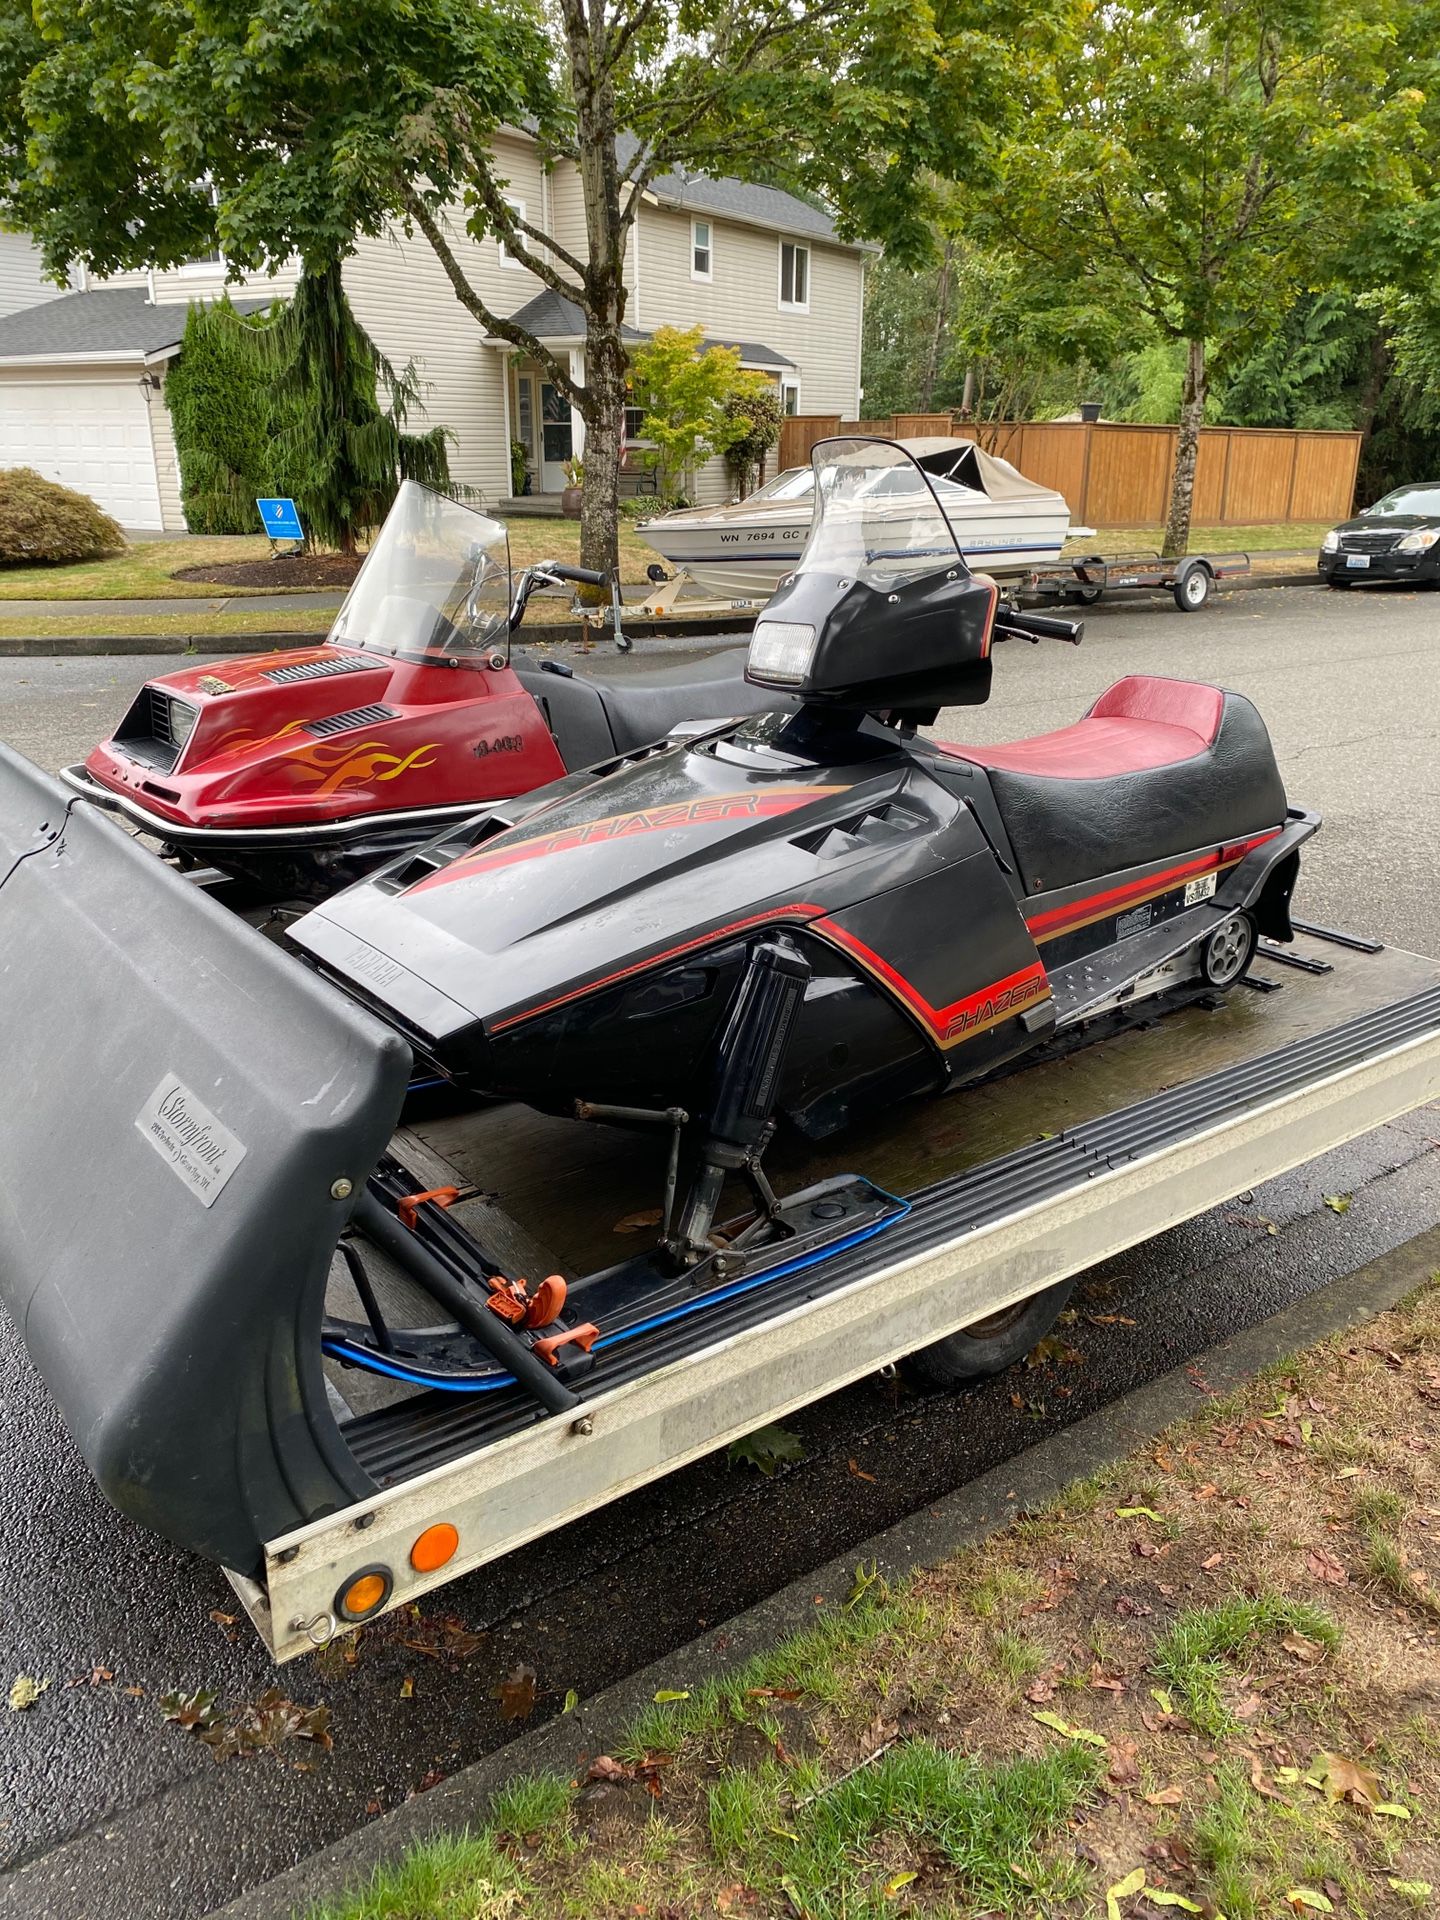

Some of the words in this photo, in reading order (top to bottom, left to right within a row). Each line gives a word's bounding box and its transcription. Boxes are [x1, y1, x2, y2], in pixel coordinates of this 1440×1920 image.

[720, 534, 739, 542] WN
[746, 532, 775, 541] 7694
[782, 530, 799, 539] GC
[969, 537, 1023, 547] BAYLINER
[547, 794, 760, 852] PHAZER
[344, 944, 405, 988] YAMAHA
[946, 975, 1041, 1040] PHAZER
[159, 1090, 228, 1167] Stormfront
